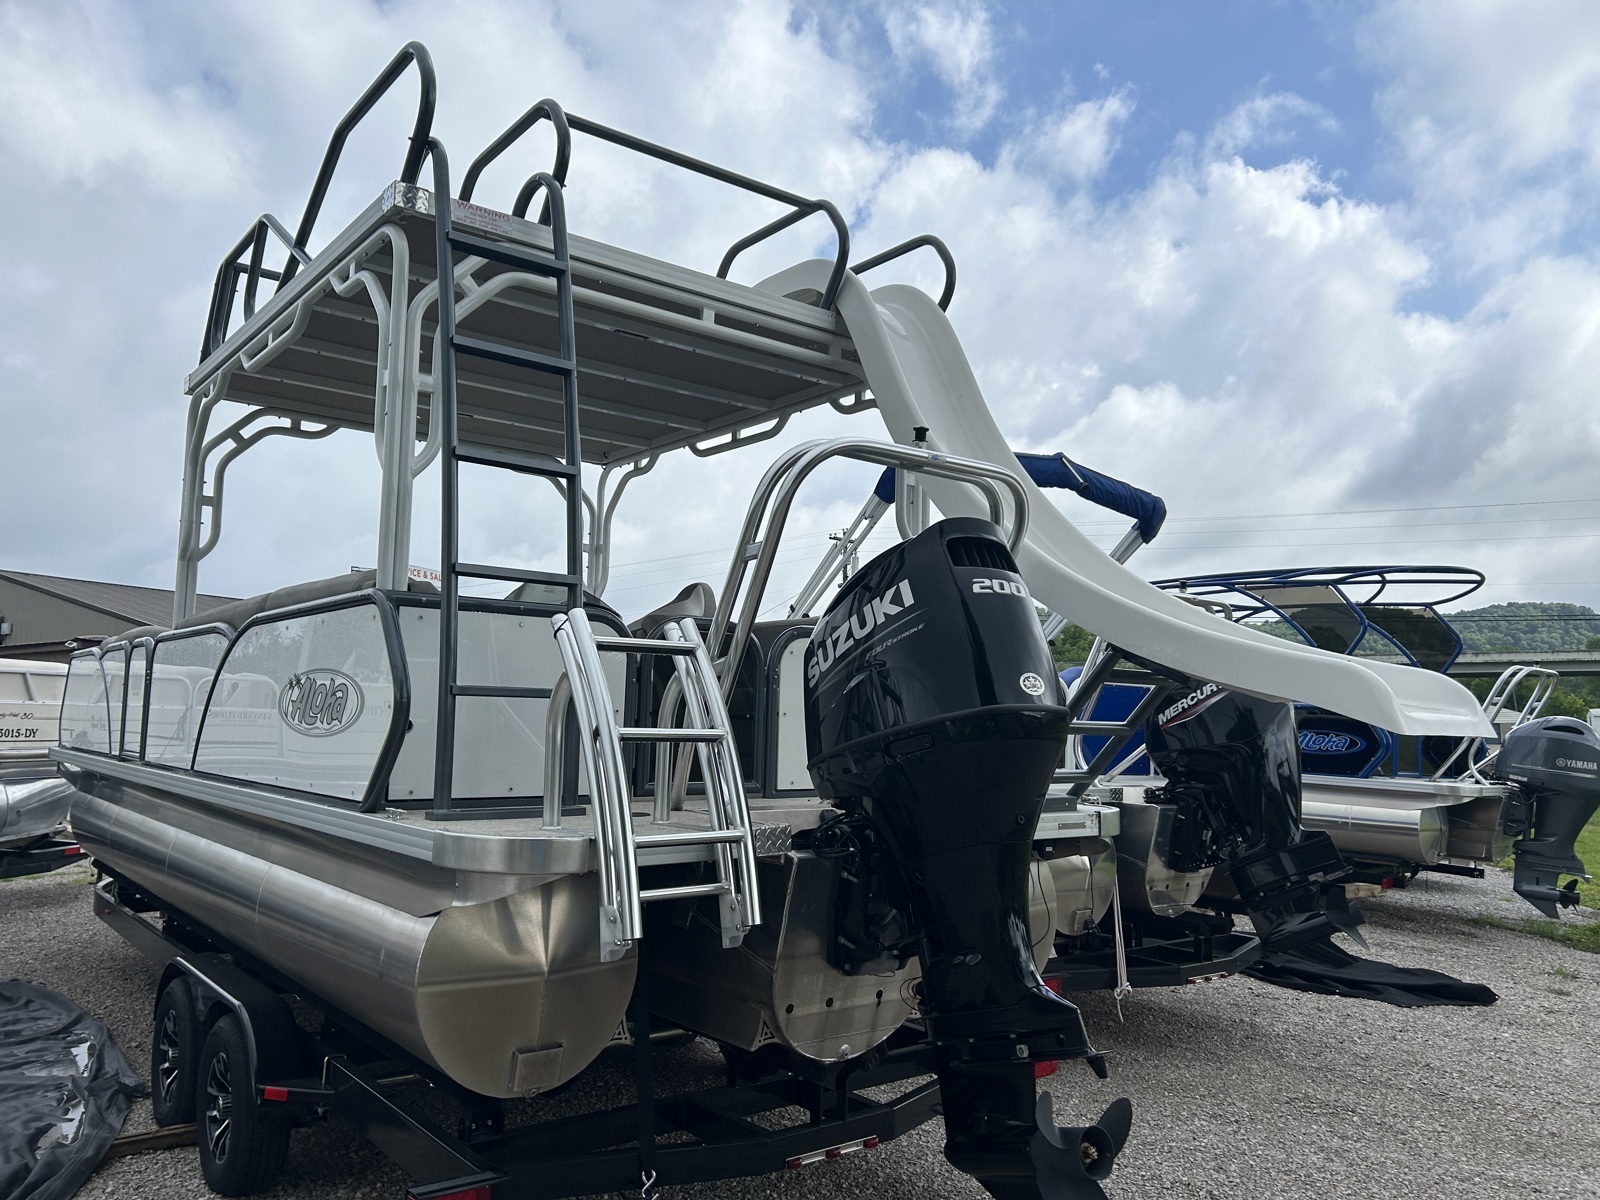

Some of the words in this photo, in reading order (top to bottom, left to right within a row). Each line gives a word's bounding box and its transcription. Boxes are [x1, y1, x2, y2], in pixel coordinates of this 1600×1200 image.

[456, 200, 511, 222] WARNING
[409, 568, 421, 578] ICE
[423, 571, 428, 579] &
[972, 578, 1027, 598] 200
[807, 579, 915, 689] SUZUKI
[1158, 682, 1222, 726] MERCUR
[1566, 759, 1598, 771] YAMAHA
